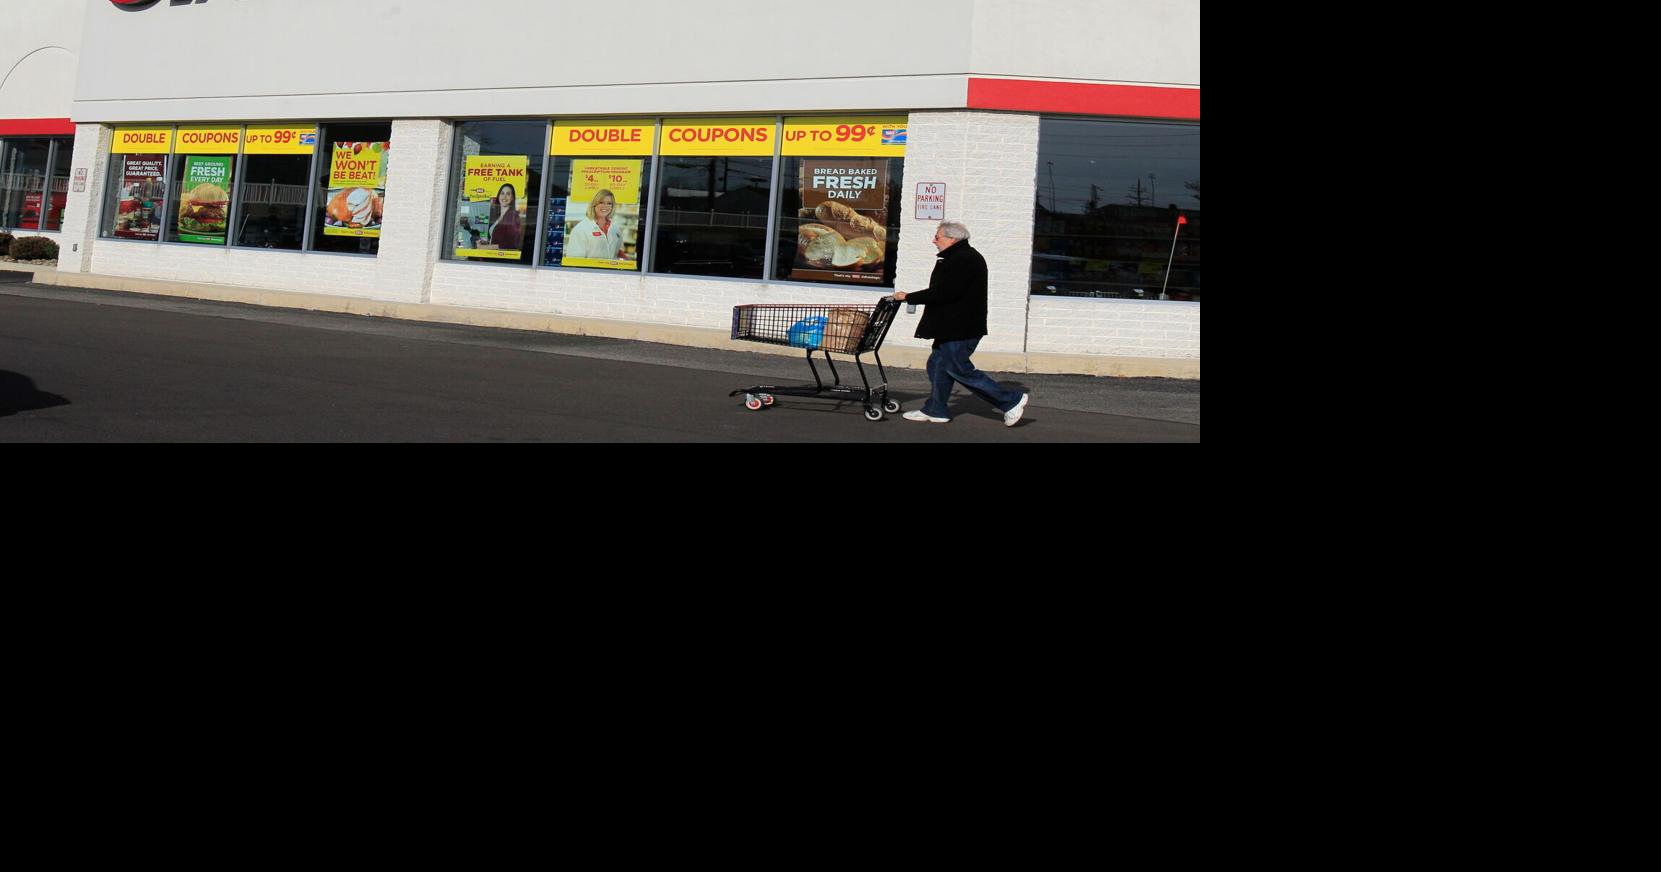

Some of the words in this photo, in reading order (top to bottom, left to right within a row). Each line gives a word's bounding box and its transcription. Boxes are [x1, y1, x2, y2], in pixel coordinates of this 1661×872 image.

[123, 133, 166, 144] DOUBLE
[182, 132, 239, 143] COUPONS
[246, 134, 258, 143] UP
[260, 134, 272, 143] TO
[274, 130, 296, 143] 99¢
[568, 128, 642, 142] DOUBLE
[668, 128, 768, 142] COUPONS
[785, 130, 806, 142] UP
[810, 130, 832, 142] TO
[836, 124, 876, 142] 99¢
[336, 151, 352, 159] WE
[335, 160, 376, 170] WON'T
[190, 166, 225, 177] FRESH
[812, 176, 877, 189] FRESH
[828, 190, 862, 199] DAILY
